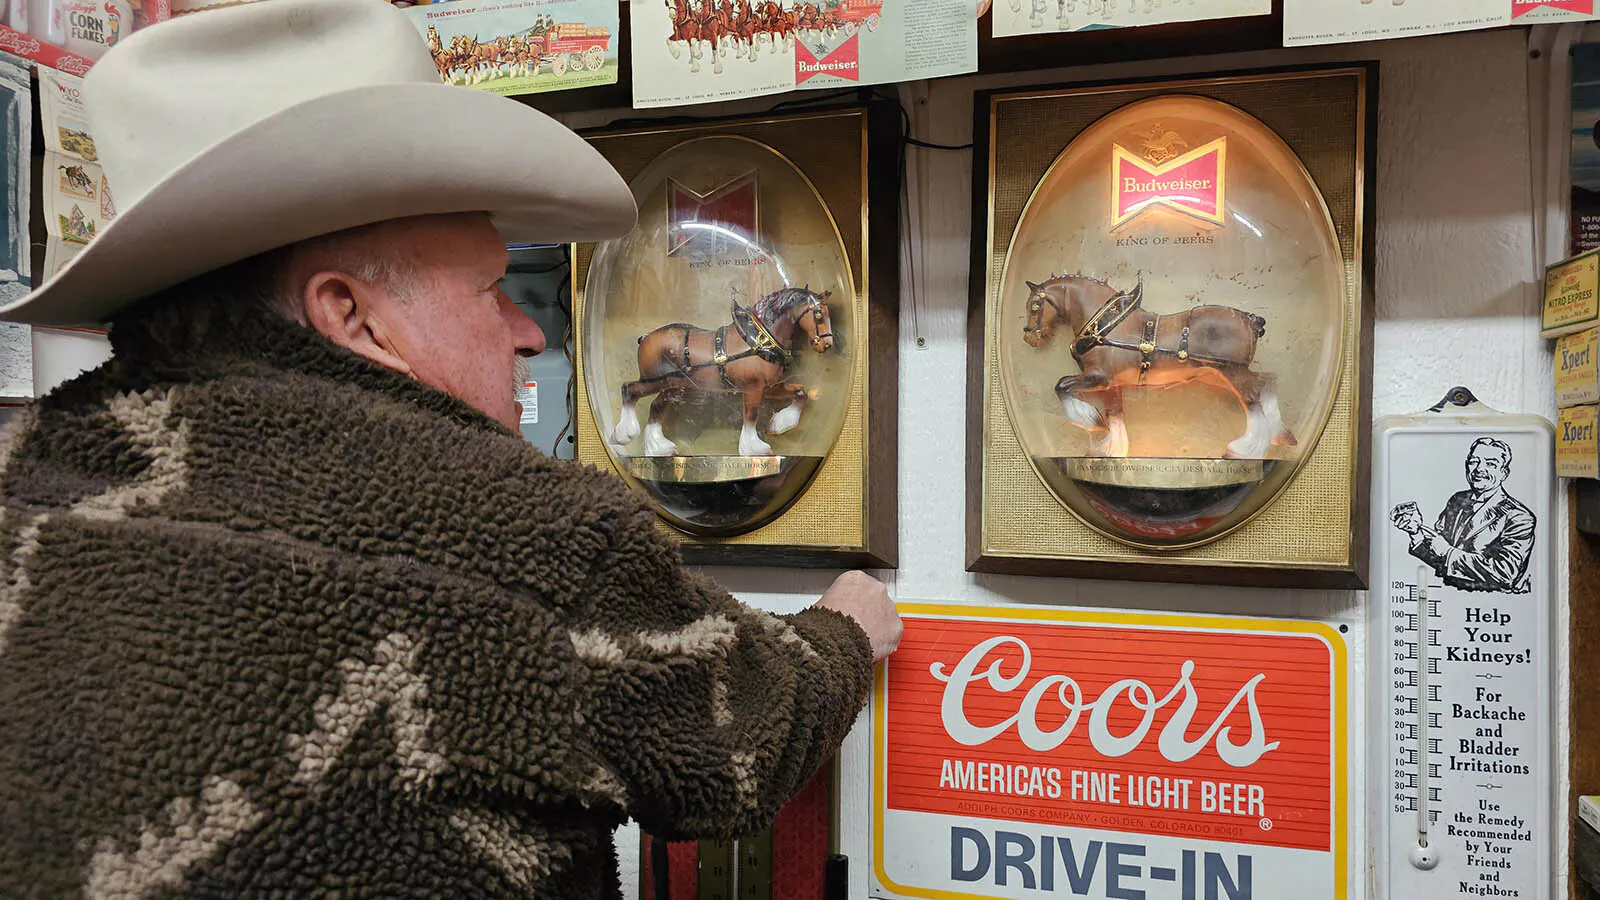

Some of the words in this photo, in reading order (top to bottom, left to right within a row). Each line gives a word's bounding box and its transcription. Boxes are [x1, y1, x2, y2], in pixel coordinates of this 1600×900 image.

[426, 6, 477, 19] Budweiser
[70, 11, 104, 32] CORN
[71, 27, 105, 44] FLAKES
[799, 60, 858, 73] Budweiser
[1123, 177, 1208, 193] Budweiser
[1116, 236, 1148, 247] KING
[1152, 236, 1169, 245] OF
[1173, 235, 1214, 245] BEERS
[1548, 296, 1566, 309] NITRO
[1567, 289, 1593, 305] EXPRESS
[1561, 344, 1590, 373] Xpert
[1562, 421, 1593, 445] Xpert
[1391, 581, 1405, 589] 120
[1391, 610, 1405, 618] 100
[1465, 607, 1512, 626] Help
[1394, 625, 1405, 633] 90
[1464, 627, 1513, 643] Your
[1394, 639, 1405, 647] 80
[1394, 653, 1405, 661] 70
[1446, 646, 1531, 666] Kidneys!
[1394, 667, 1405, 675] 60
[1394, 681, 1405, 689] 50
[929, 635, 1281, 768] Coors
[1475, 687, 1503, 703] For
[1394, 708, 1405, 716] 30
[1452, 703, 1526, 721] Backache
[1475, 723, 1503, 738] and
[1459, 738, 1520, 756] Bladder
[1449, 755, 1530, 775] Irritations
[939, 758, 1062, 800] AMERICA'S
[1070, 769, 1122, 805] FINE
[1127, 774, 1194, 811] LIGHT
[1201, 780, 1266, 818] BEER
[1394, 782, 1405, 790] 30
[1394, 805, 1405, 813] 50
[1478, 799, 1501, 812] Use
[957, 801, 999, 815] ADOLPH
[1000, 805, 1036, 818] COORS
[1039, 808, 1092, 823] COMPANY
[1100, 815, 1145, 829] GOLDEN,
[1149, 818, 1212, 836] COLORADO
[1454, 812, 1473, 824] the
[1478, 813, 1525, 829] Remedy
[1447, 824, 1532, 842] Recommended
[1465, 841, 1480, 854] by
[1483, 841, 1513, 854] Your
[950, 825, 1253, 900] DRIVE-IN
[1466, 854, 1512, 869] Friends
[1479, 871, 1500, 882] and
[1459, 881, 1519, 898] Neighbors
